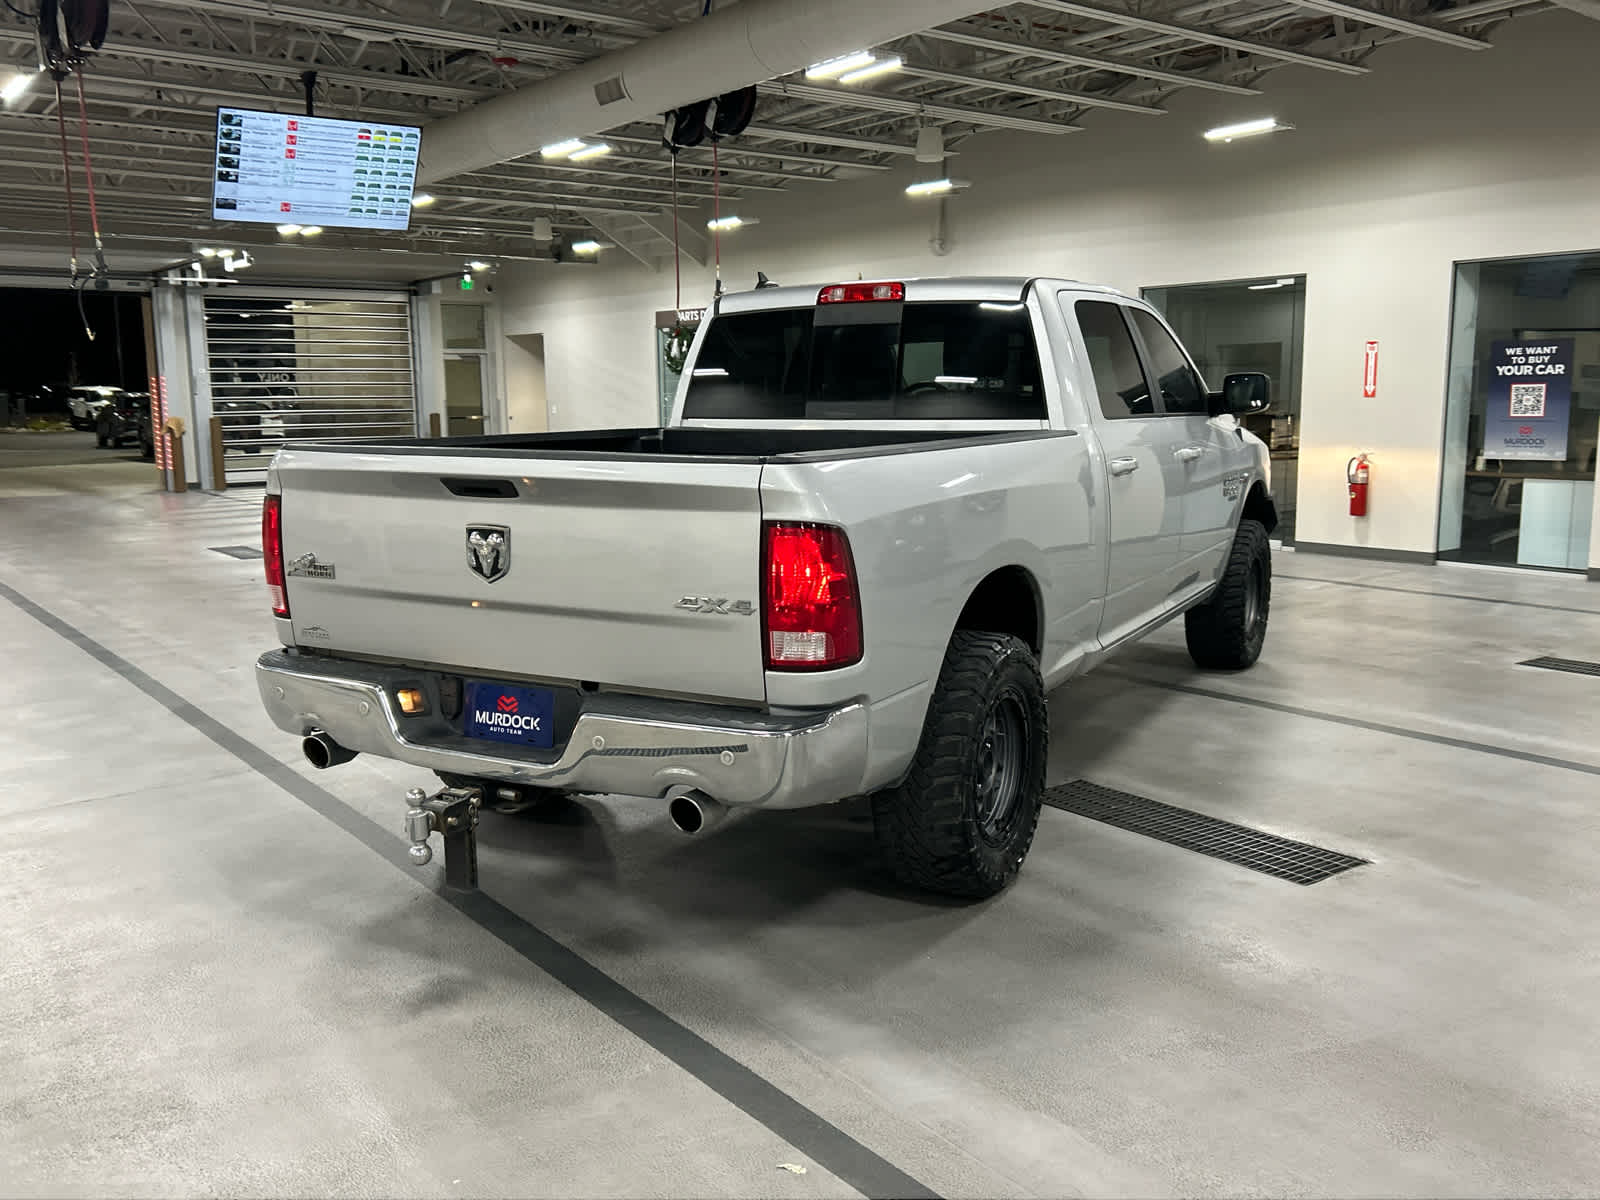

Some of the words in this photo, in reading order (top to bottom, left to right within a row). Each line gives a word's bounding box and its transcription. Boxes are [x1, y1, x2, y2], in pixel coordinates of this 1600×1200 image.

[1505, 347, 1523, 356] WE
[1525, 345, 1558, 355] WANT
[1511, 356, 1526, 364] TO
[1528, 355, 1551, 364] BUY
[1496, 365, 1533, 376] YOUR
[1535, 364, 1565, 375] CAR
[475, 710, 541, 731] MURDOCK
